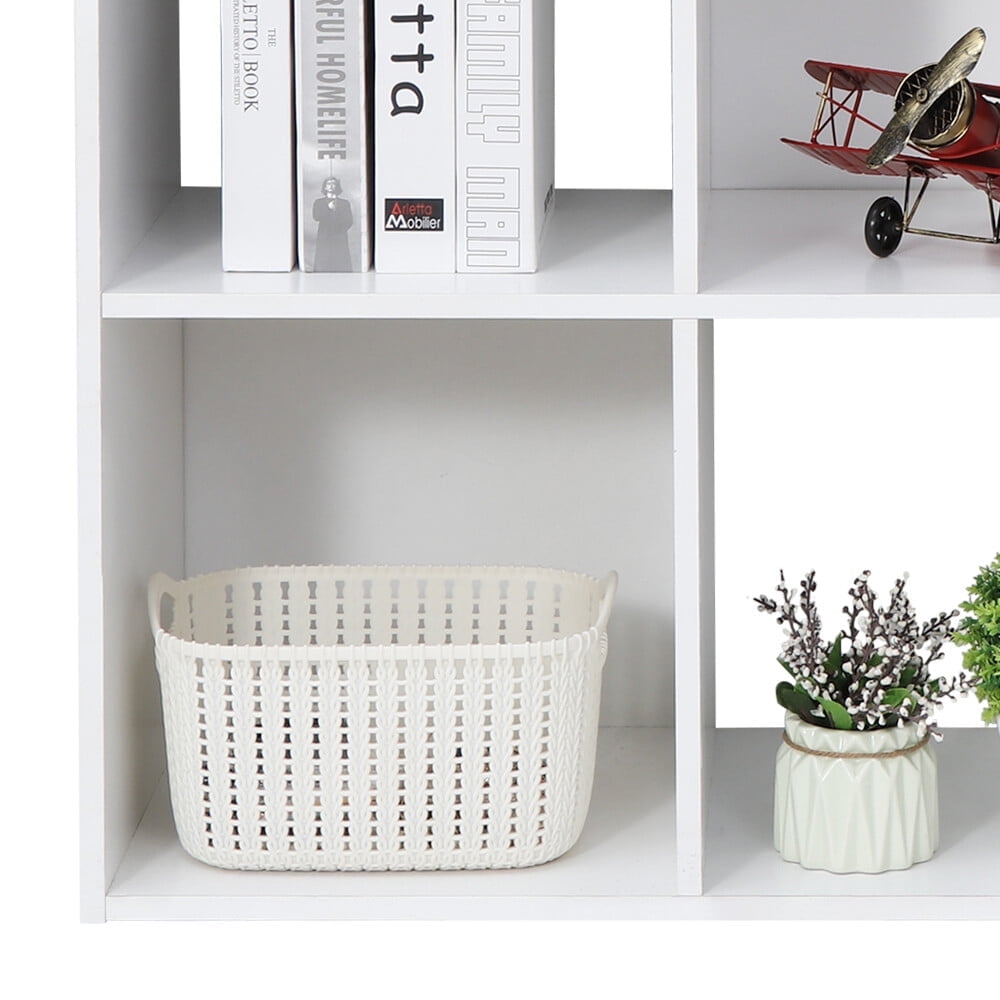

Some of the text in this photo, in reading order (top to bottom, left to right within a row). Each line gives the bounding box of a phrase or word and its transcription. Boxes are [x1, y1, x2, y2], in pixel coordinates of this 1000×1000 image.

[267, 28, 276, 47] THE
[243, 61, 259, 112] BOOK
[316, 53, 347, 160] HOMELIFE
[385, 214, 441, 229] Mobilier
[391, 201, 433, 215] Arletta
[466, 166, 520, 268] MAN
